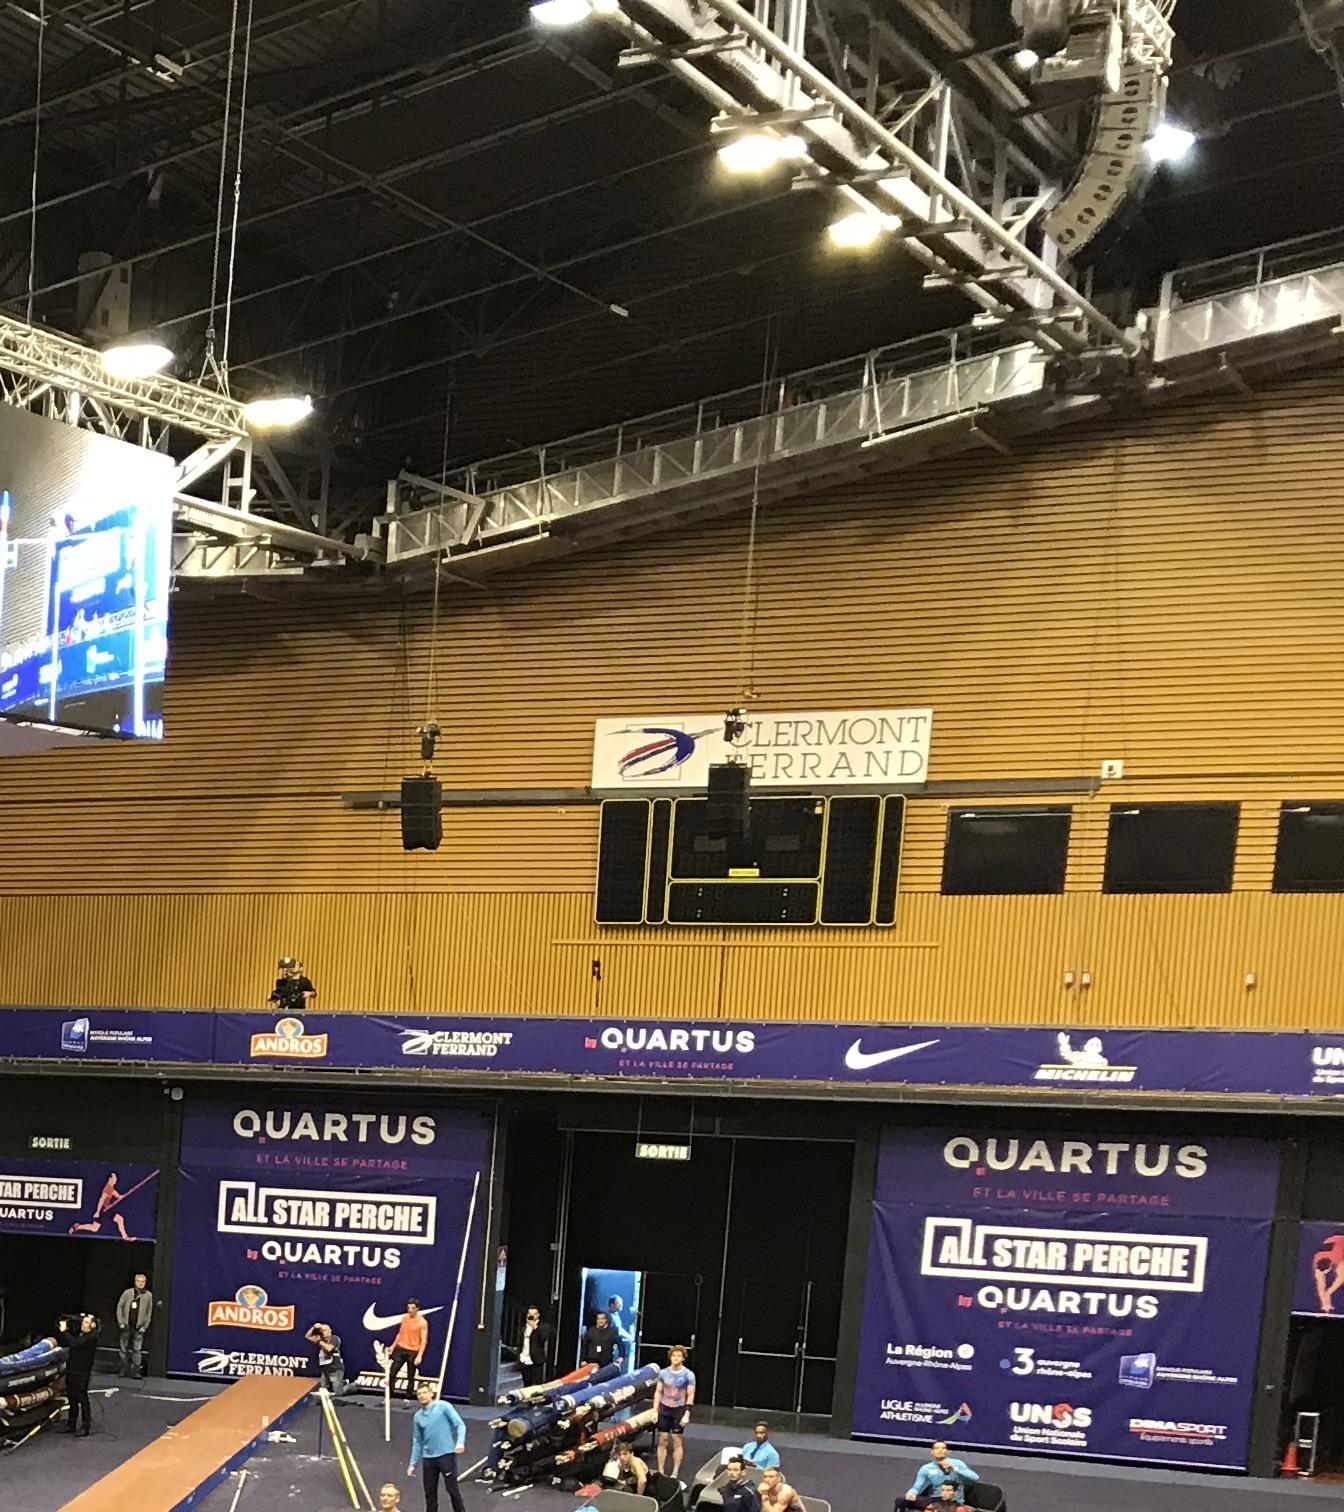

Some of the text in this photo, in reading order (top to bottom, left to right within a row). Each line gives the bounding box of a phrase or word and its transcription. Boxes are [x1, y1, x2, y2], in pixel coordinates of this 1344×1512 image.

[729, 716, 927, 748] CLERMONT
[254, 1037, 322, 1054] ANDROS
[433, 1031, 513, 1045] CLERMONT
[601, 1027, 755, 1052] QUARTUS
[432, 1044, 498, 1056] FERRAND
[1035, 1068, 1135, 1082] MICHELIN
[233, 1109, 437, 1145] QUARTUS
[32, 1137, 70, 1149] SORTIE
[639, 1144, 688, 1158] SORTIE
[256, 1154, 408, 1170] ET LA VILLE SE PARTAGE
[944, 1136, 1208, 1178] QUARTUS
[24, 1182, 75, 1201] PERCHE
[973, 1187, 1170, 1206] ET LA VILLE SE PARTAGE
[231, 1193, 423, 1232] ALL STAR PERCHE
[261, 1240, 401, 1269] QUARTUS
[939, 1232, 1190, 1277] ALL STAR PERCHE
[977, 1285, 1160, 1319] QUARTUS
[212, 1305, 289, 1327] ANDROS
[229, 1351, 309, 1369] CLERMONT
[887, 1343, 953, 1359] La Région
[1012, 1347, 1035, 1375] 3
[1037, 1359, 1081, 1369] auvergne
[881, 1399, 913, 1411] LIGUE
[880, 1412, 934, 1424] ATHLETISME
[1010, 1402, 1093, 1428] UNSS
[1013, 1425, 1041, 1435] Union
[1025, 1434, 1051, 1445] Sport
